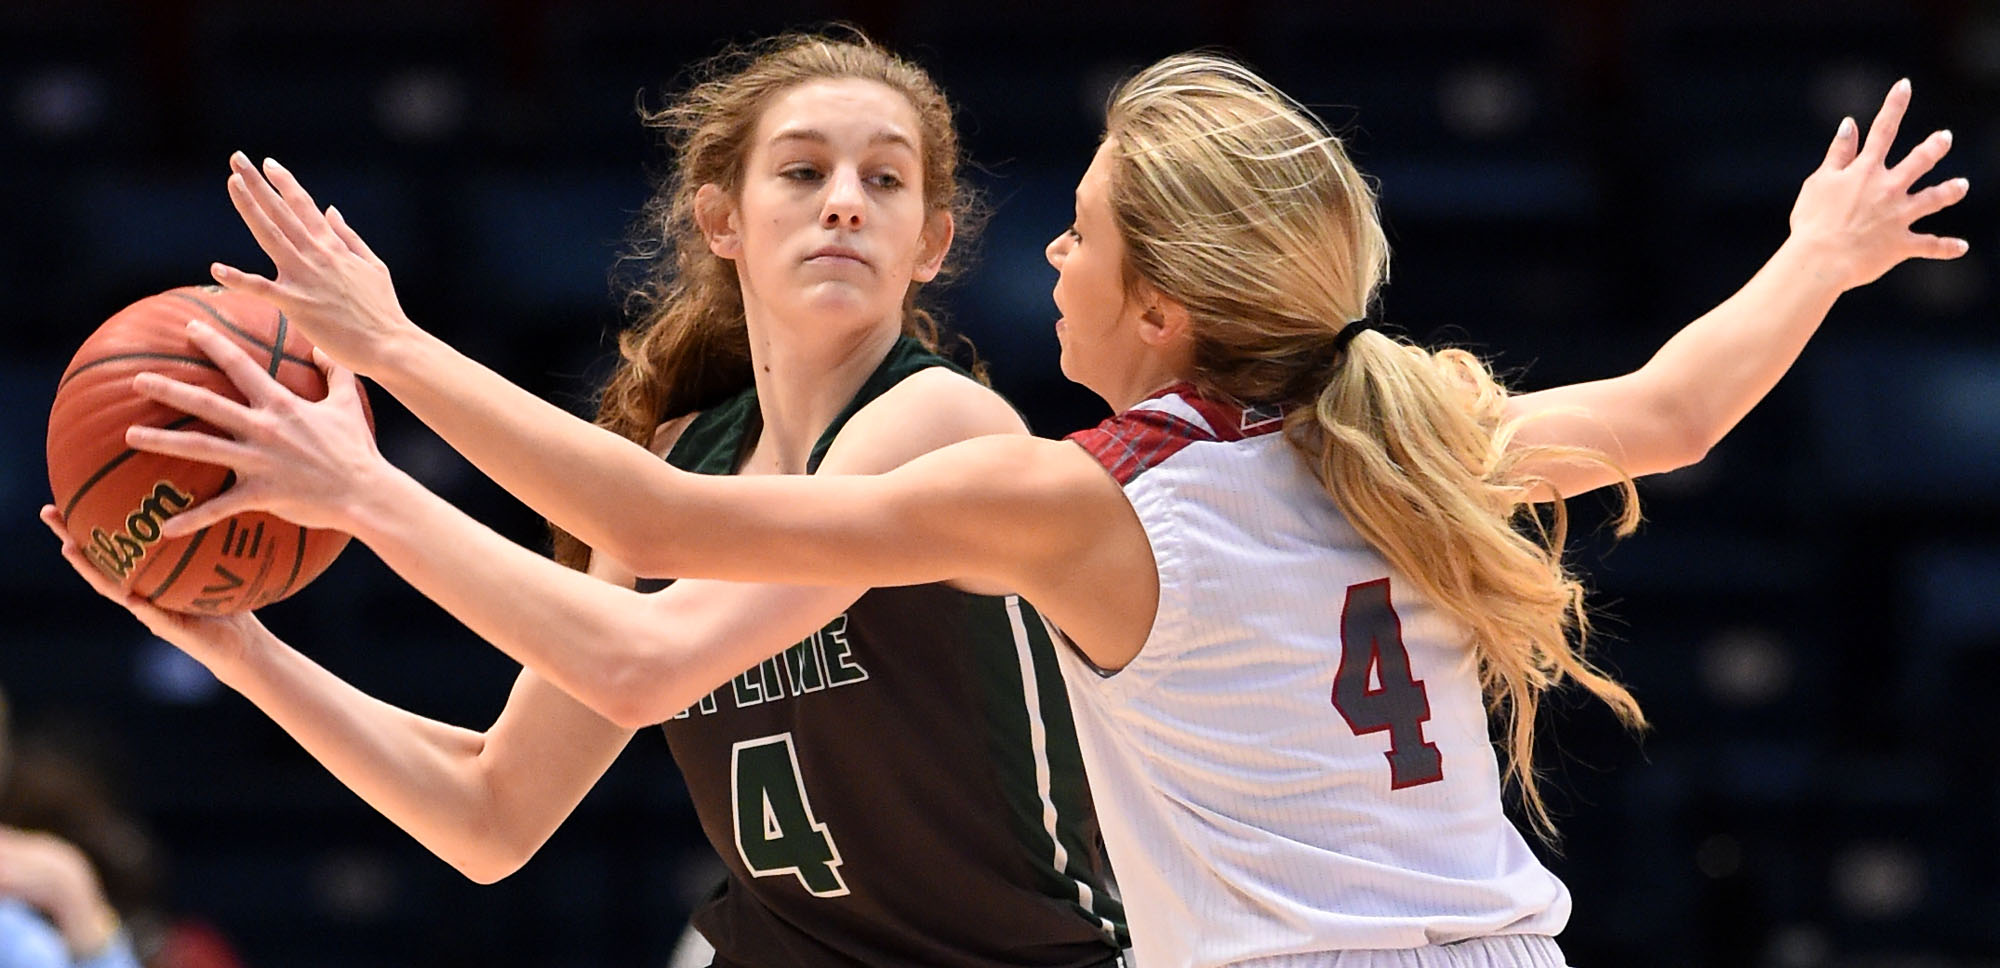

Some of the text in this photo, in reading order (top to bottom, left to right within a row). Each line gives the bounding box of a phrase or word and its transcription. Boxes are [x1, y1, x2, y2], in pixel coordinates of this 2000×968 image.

[83, 480, 194, 581] ilson
[192, 518, 264, 610] AVE
[673, 613, 869, 719] LINE
[1332, 577, 1443, 790] 4
[731, 732, 850, 897] 4
